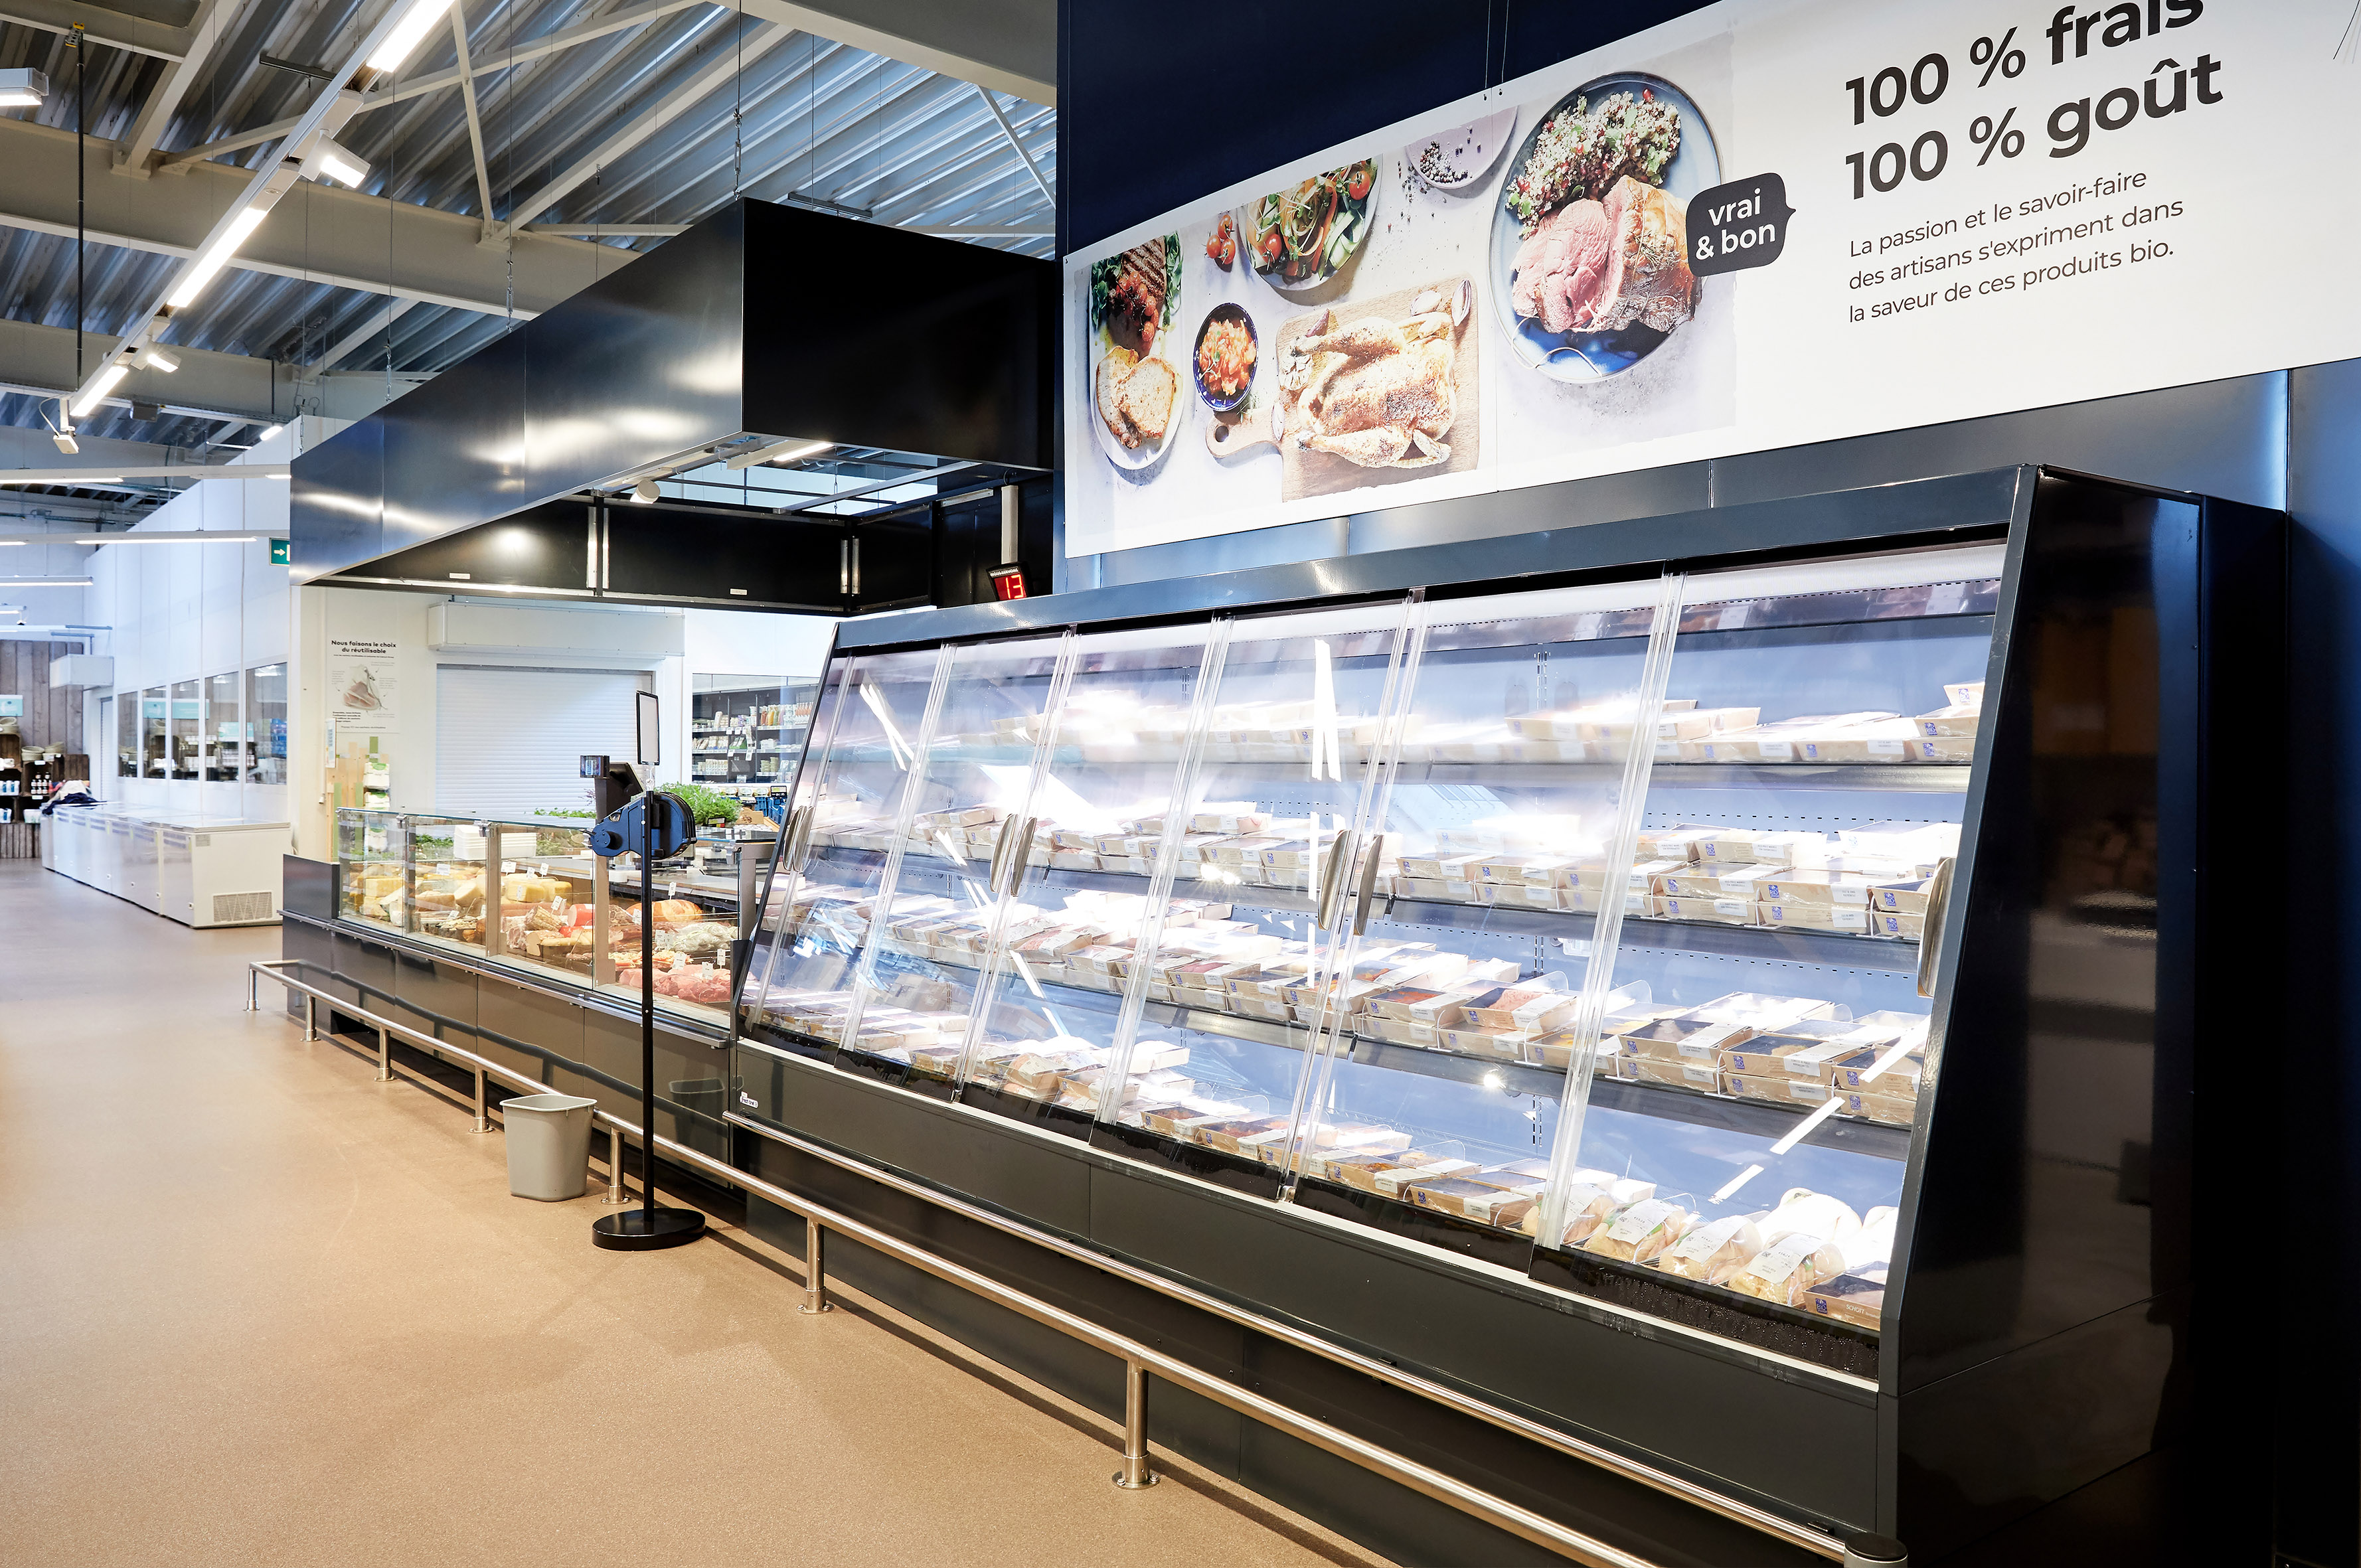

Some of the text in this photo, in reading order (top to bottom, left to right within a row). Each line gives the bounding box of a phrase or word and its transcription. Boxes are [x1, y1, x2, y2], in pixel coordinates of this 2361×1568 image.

[1846, 0, 2203, 125] 100 % frais
[1846, 54, 2223, 199] 100 % goût
[1696, 224, 1775, 260] & bon
[1708, 189, 1760, 226] vrai
[1850, 201, 2182, 289] des artisans s'expriment dans
[1851, 173, 2146, 257] La passion et le savoir-faire
[1850, 240, 2173, 322] la saveur de ces produits bio.
[1006, 574, 1023, 599] 13
